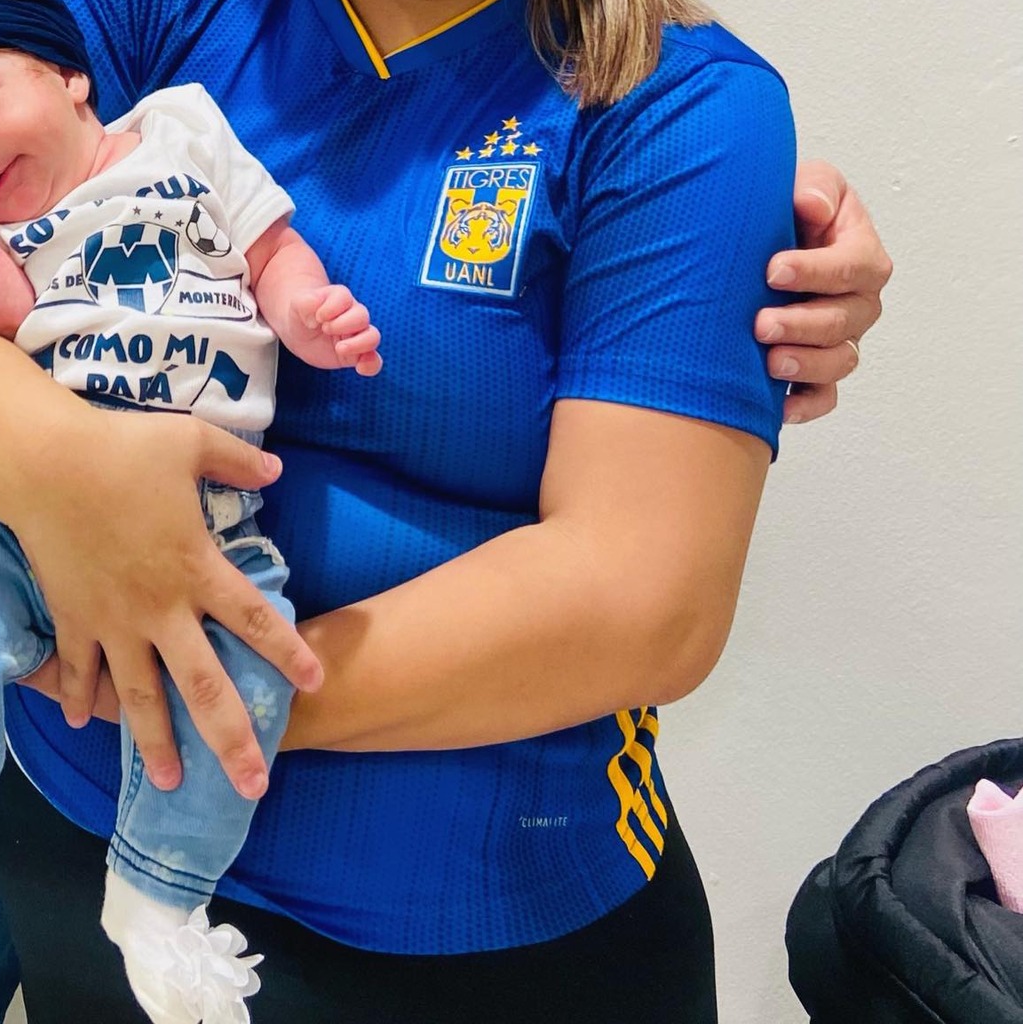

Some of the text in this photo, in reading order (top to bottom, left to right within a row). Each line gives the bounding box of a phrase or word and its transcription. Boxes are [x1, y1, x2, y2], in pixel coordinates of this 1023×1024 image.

[453, 168, 530, 190] TIGRES
[65, 273, 84, 288] DE
[444, 261, 495, 287] UANL
[58, 333, 209, 365] COMO MI
